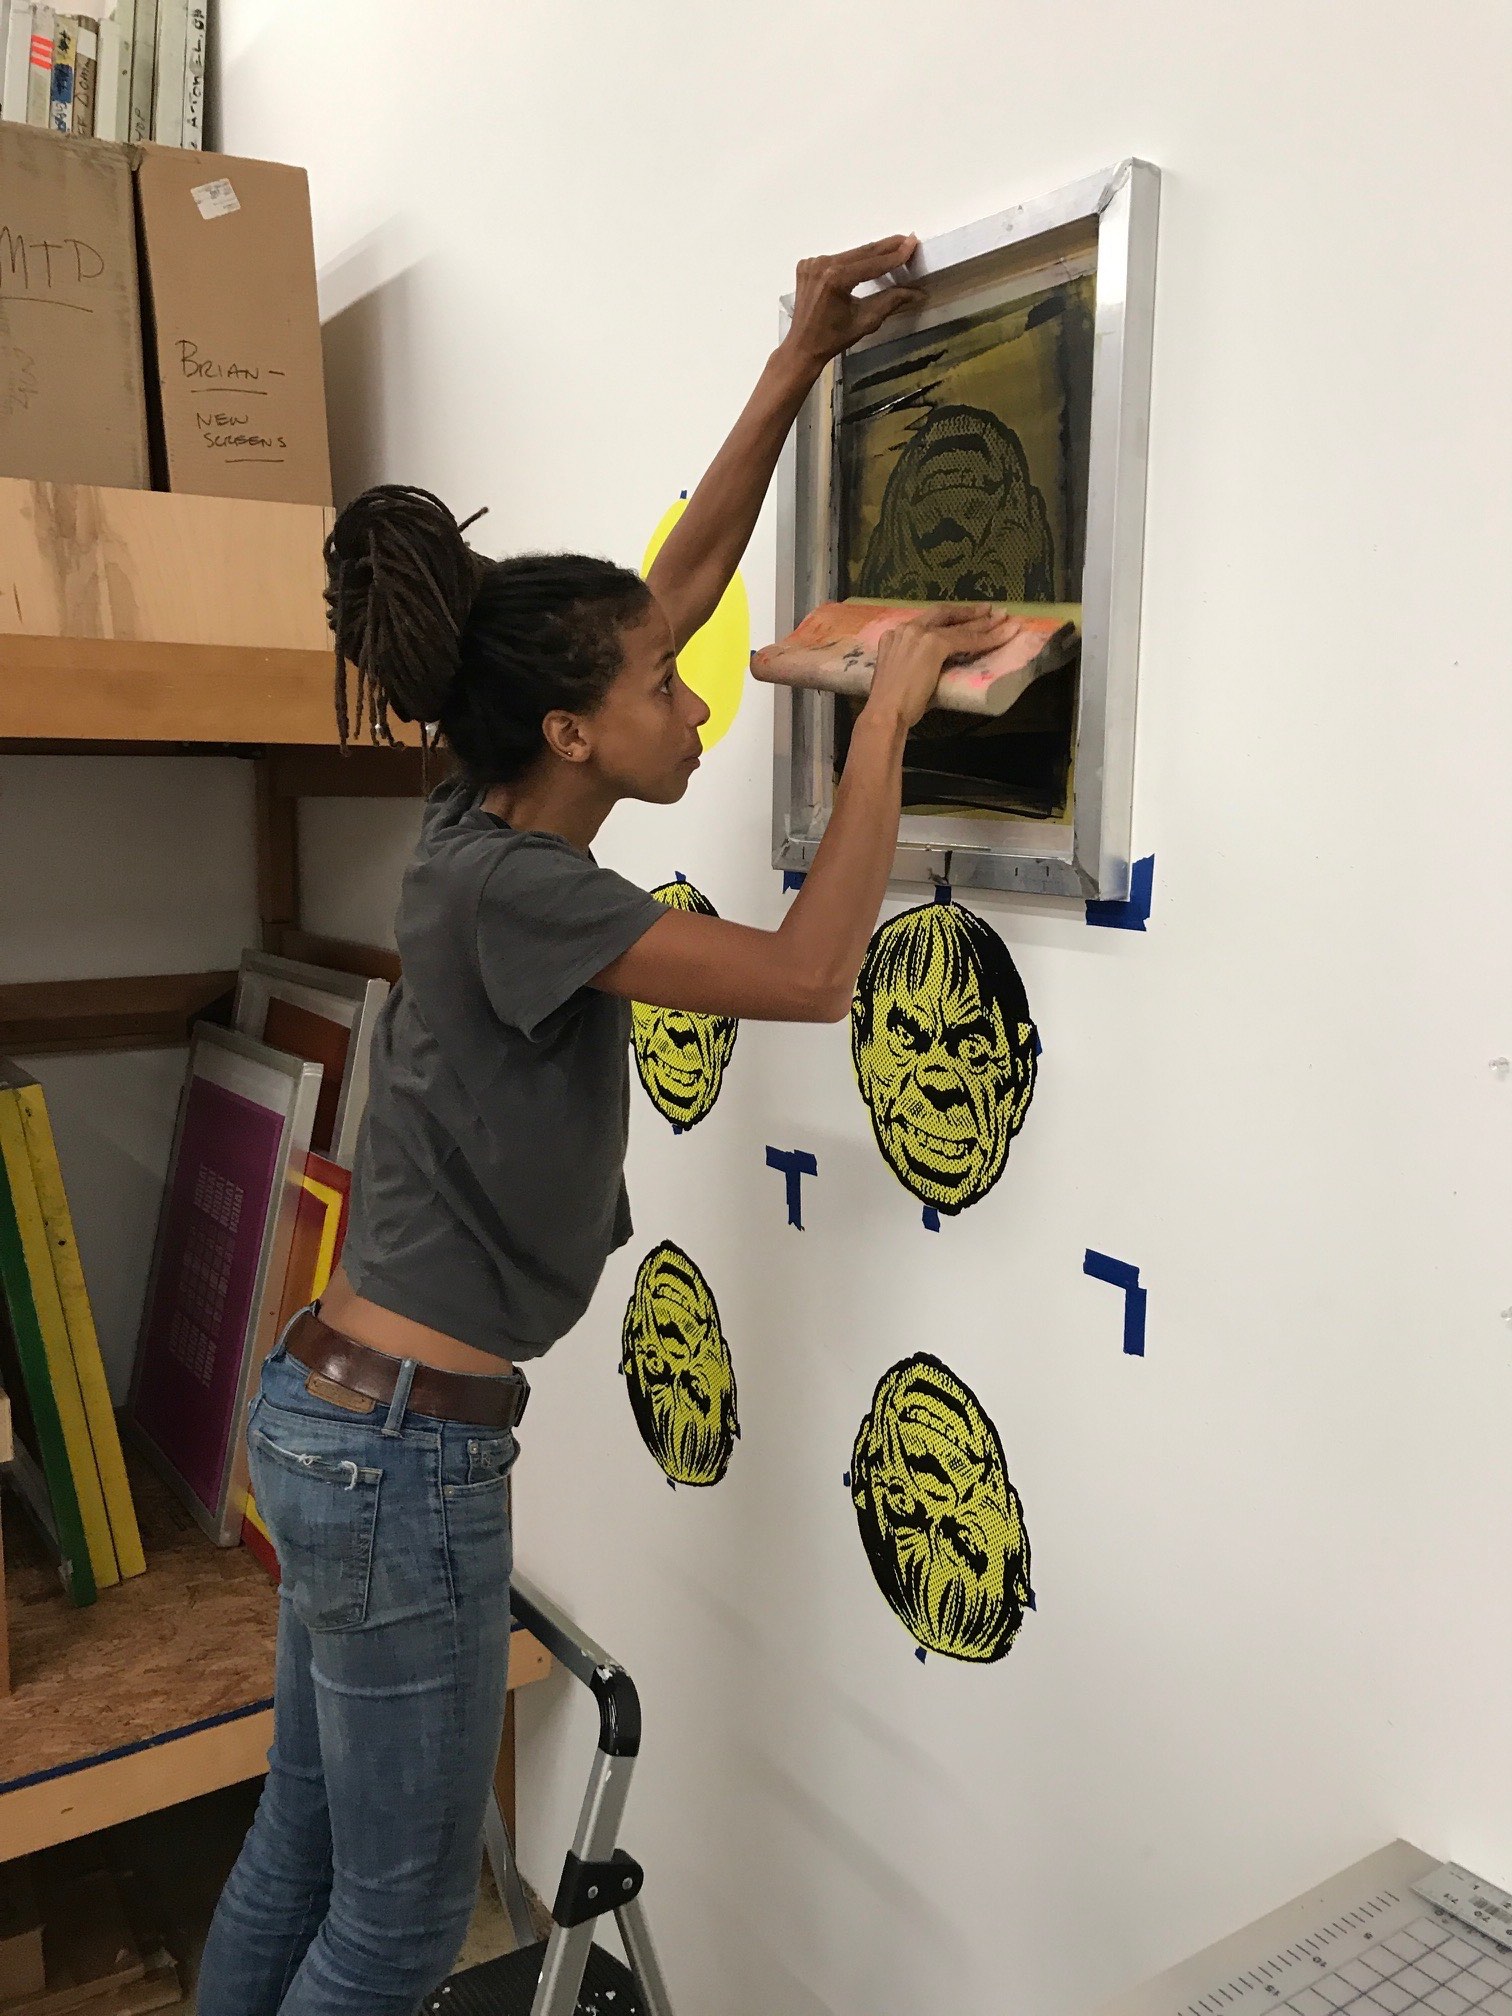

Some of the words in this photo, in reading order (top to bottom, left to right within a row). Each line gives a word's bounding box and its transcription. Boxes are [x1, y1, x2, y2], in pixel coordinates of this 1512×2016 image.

[0, 226, 105, 289] MTD
[196, 412, 249, 429] NEW
[203, 432, 287, 448] SCREENS
